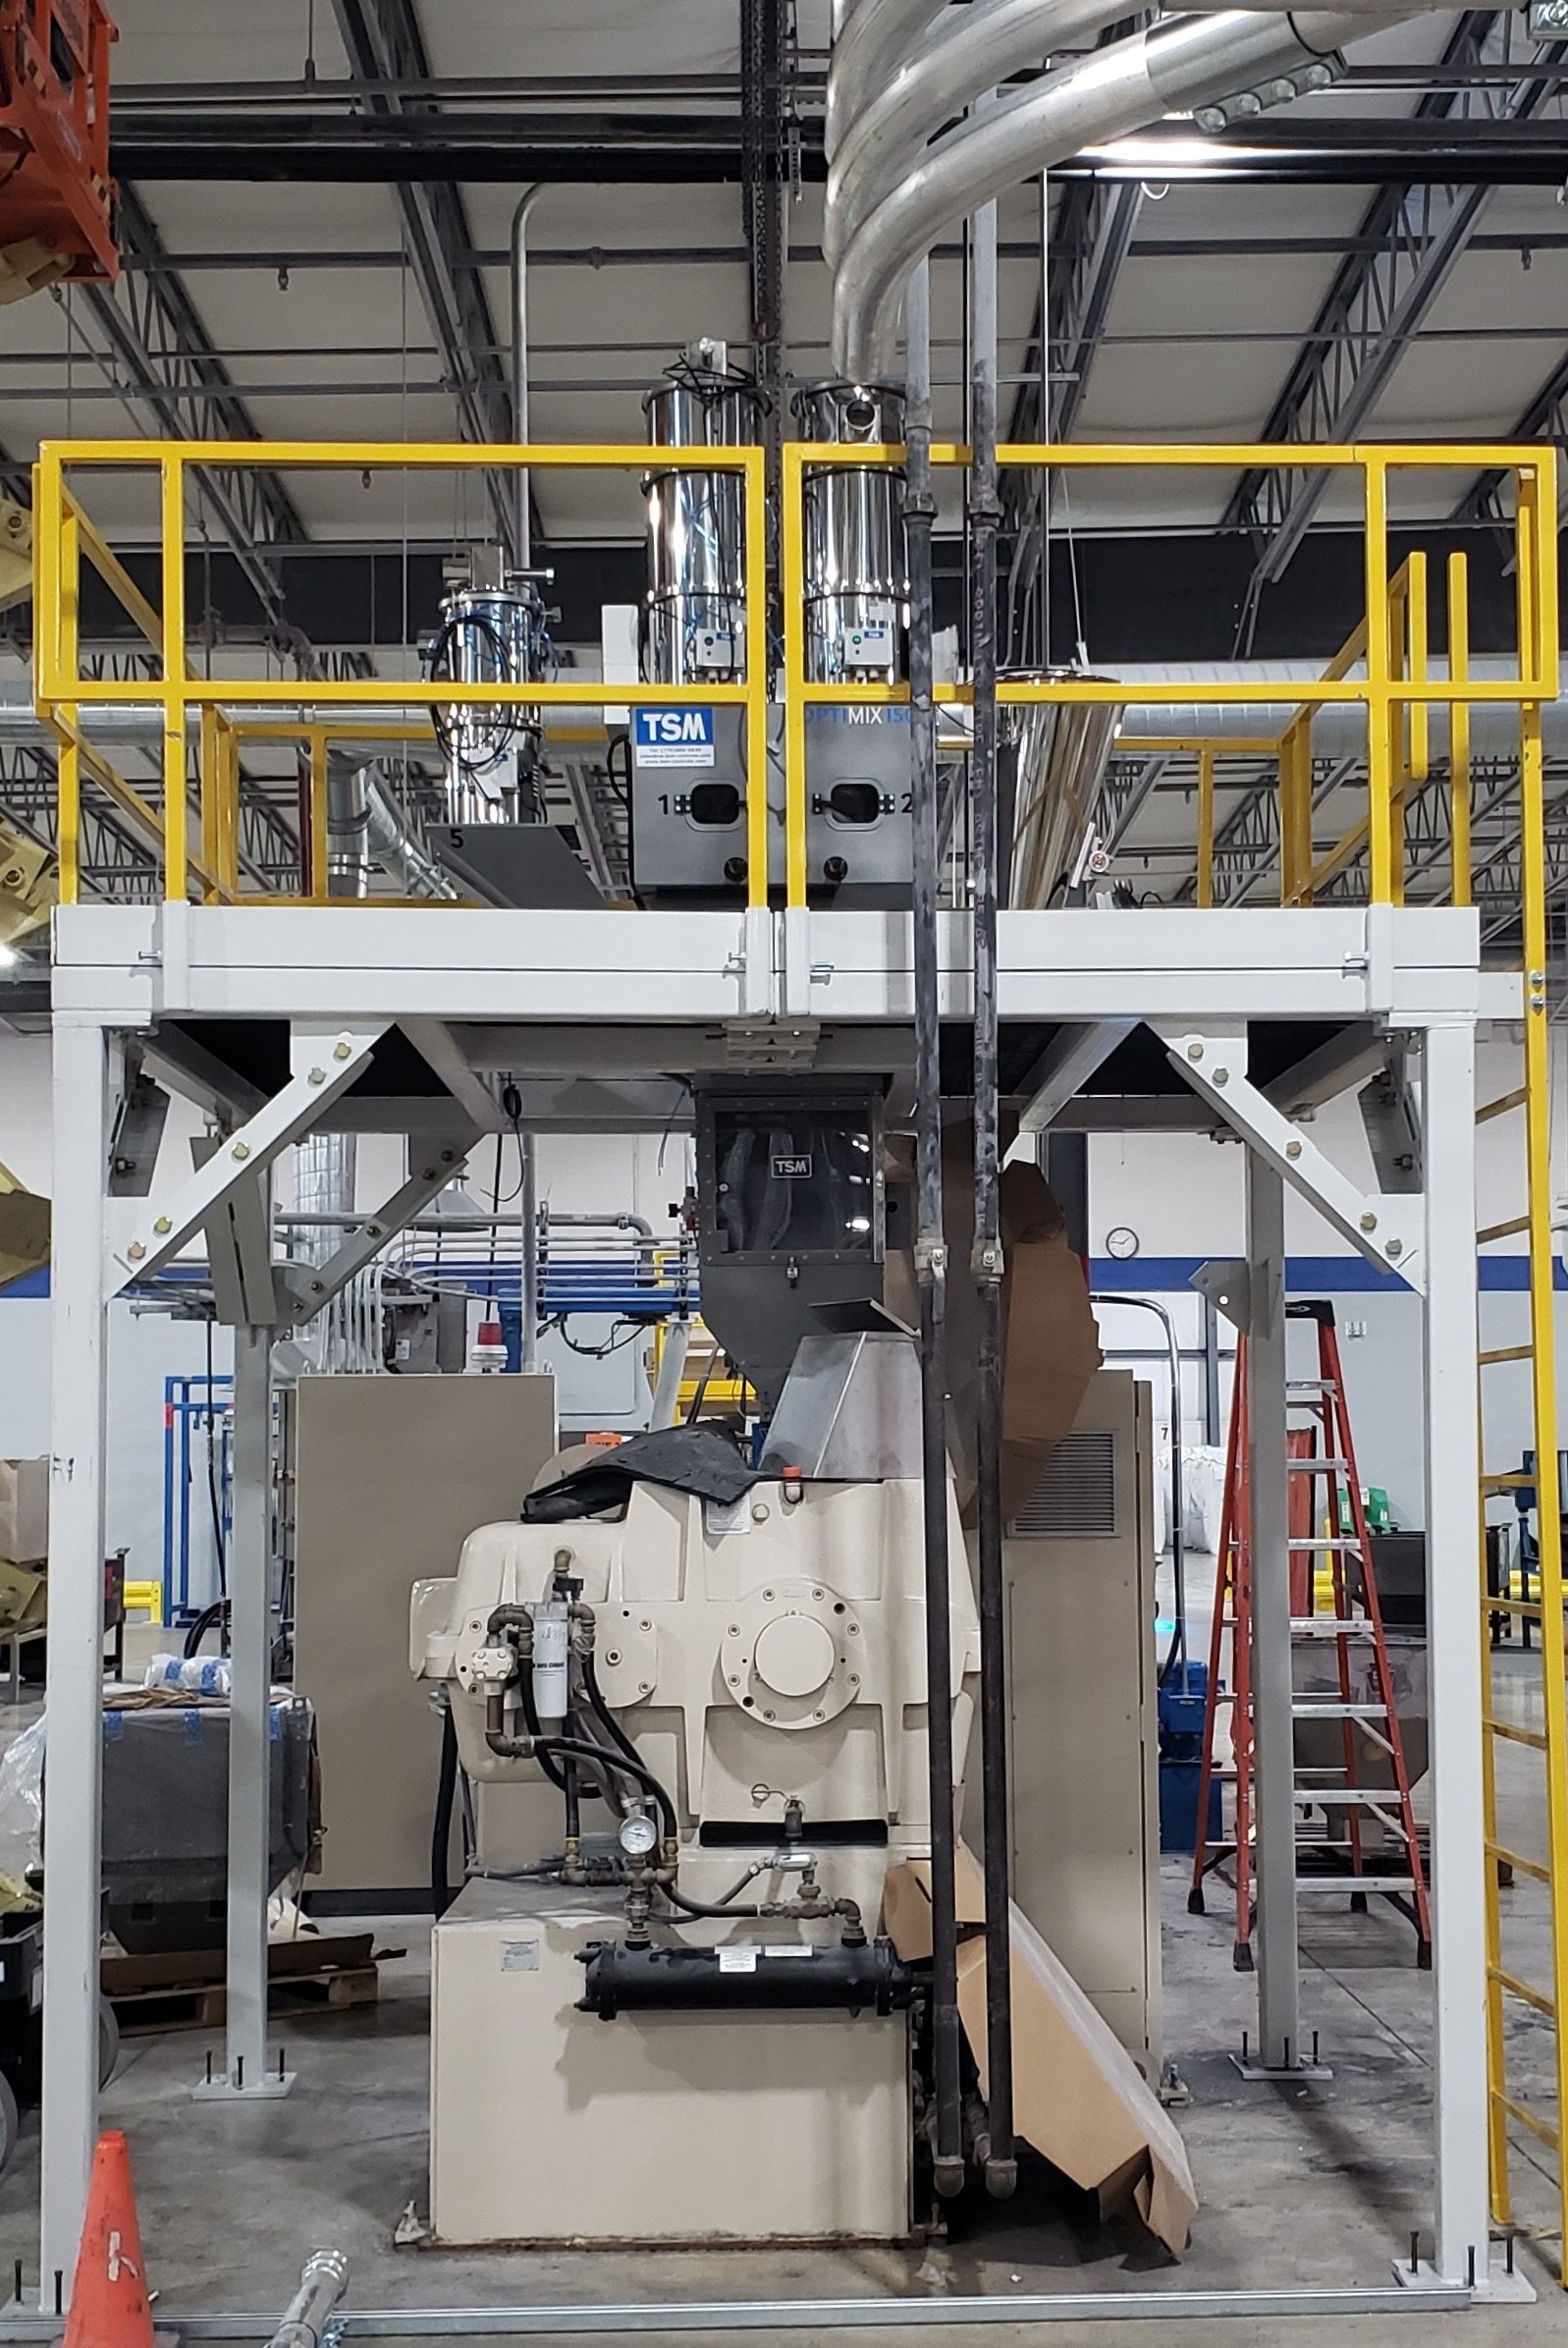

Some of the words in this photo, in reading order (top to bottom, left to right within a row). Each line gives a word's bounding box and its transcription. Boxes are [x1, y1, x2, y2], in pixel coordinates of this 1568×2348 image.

[642, 712, 707, 742] TSM
[657, 793, 669, 815] 1
[900, 792, 913, 813] 2
[450, 828, 464, 848] 5
[776, 1160, 807, 1174] TSM
[1161, 1427, 1168, 1441] 7
